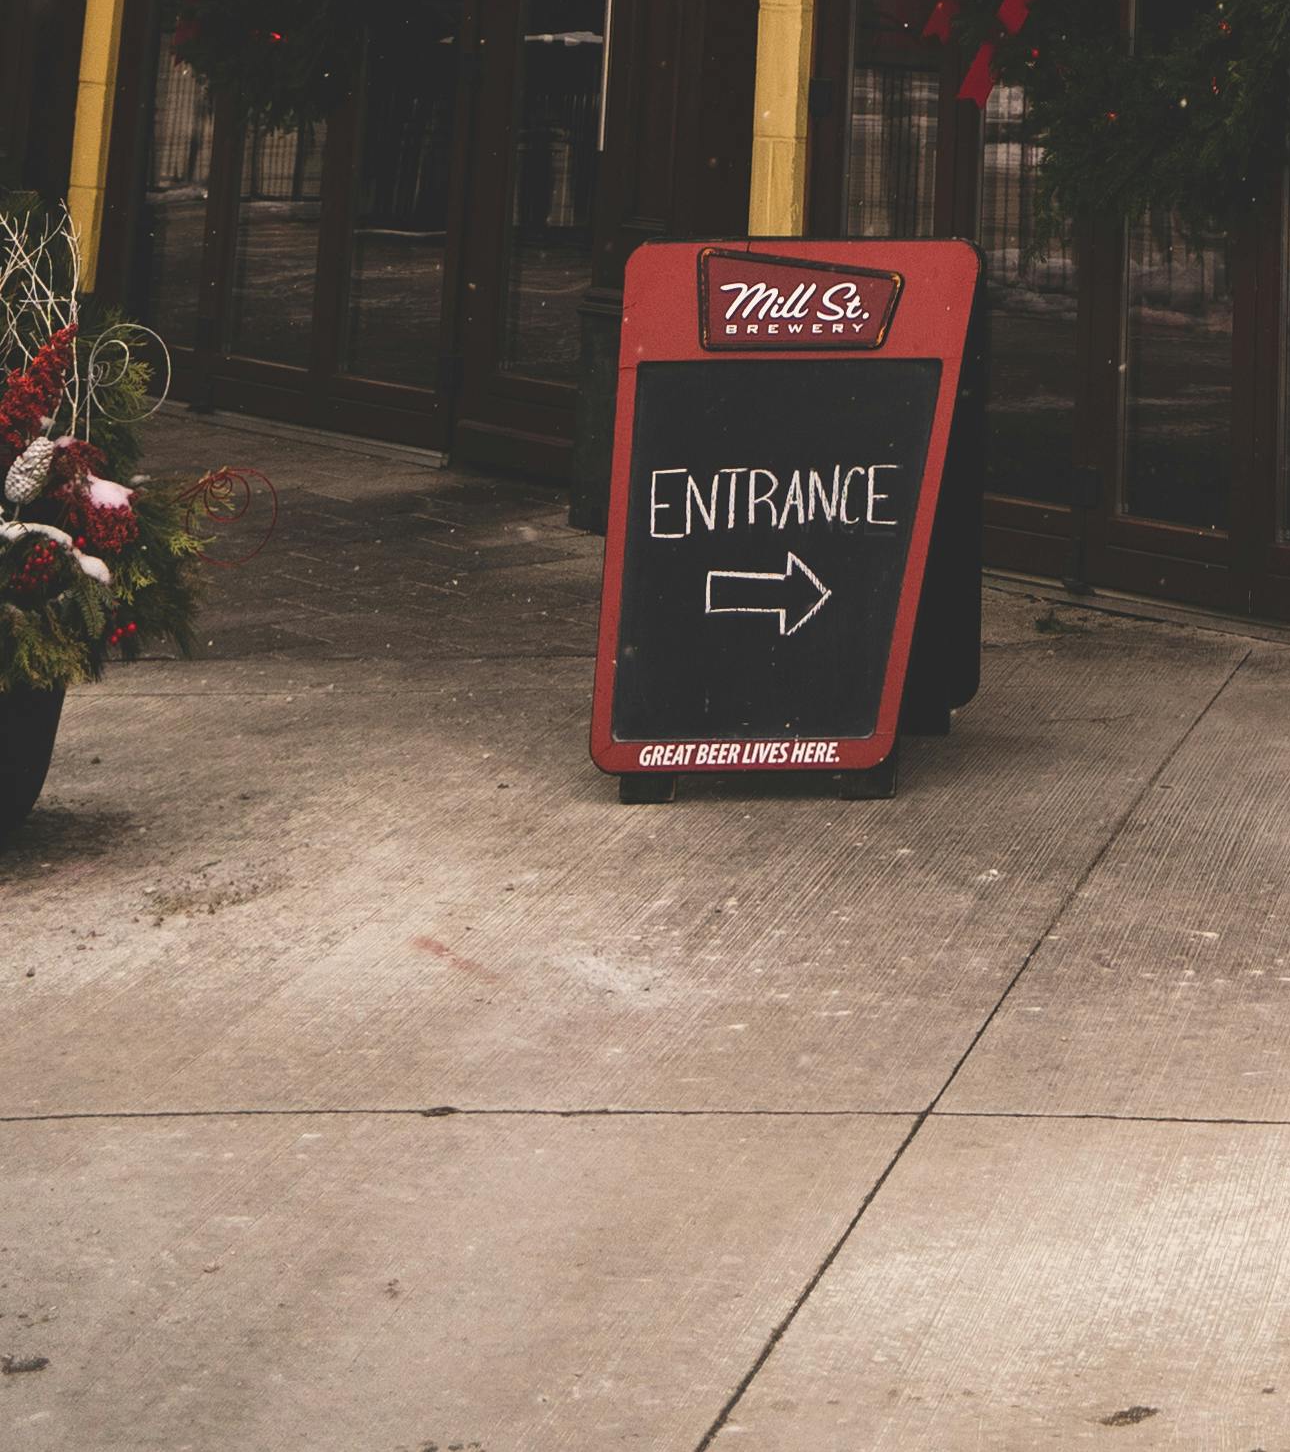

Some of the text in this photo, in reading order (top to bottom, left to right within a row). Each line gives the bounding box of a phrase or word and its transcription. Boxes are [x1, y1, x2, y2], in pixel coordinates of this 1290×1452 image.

[719, 281, 871, 320] Mill St.
[725, 322, 865, 335] BREWERY
[649, 464, 898, 539] ENTRANCE
[638, 741, 841, 767] GREAT BEER LIVES HERE.
